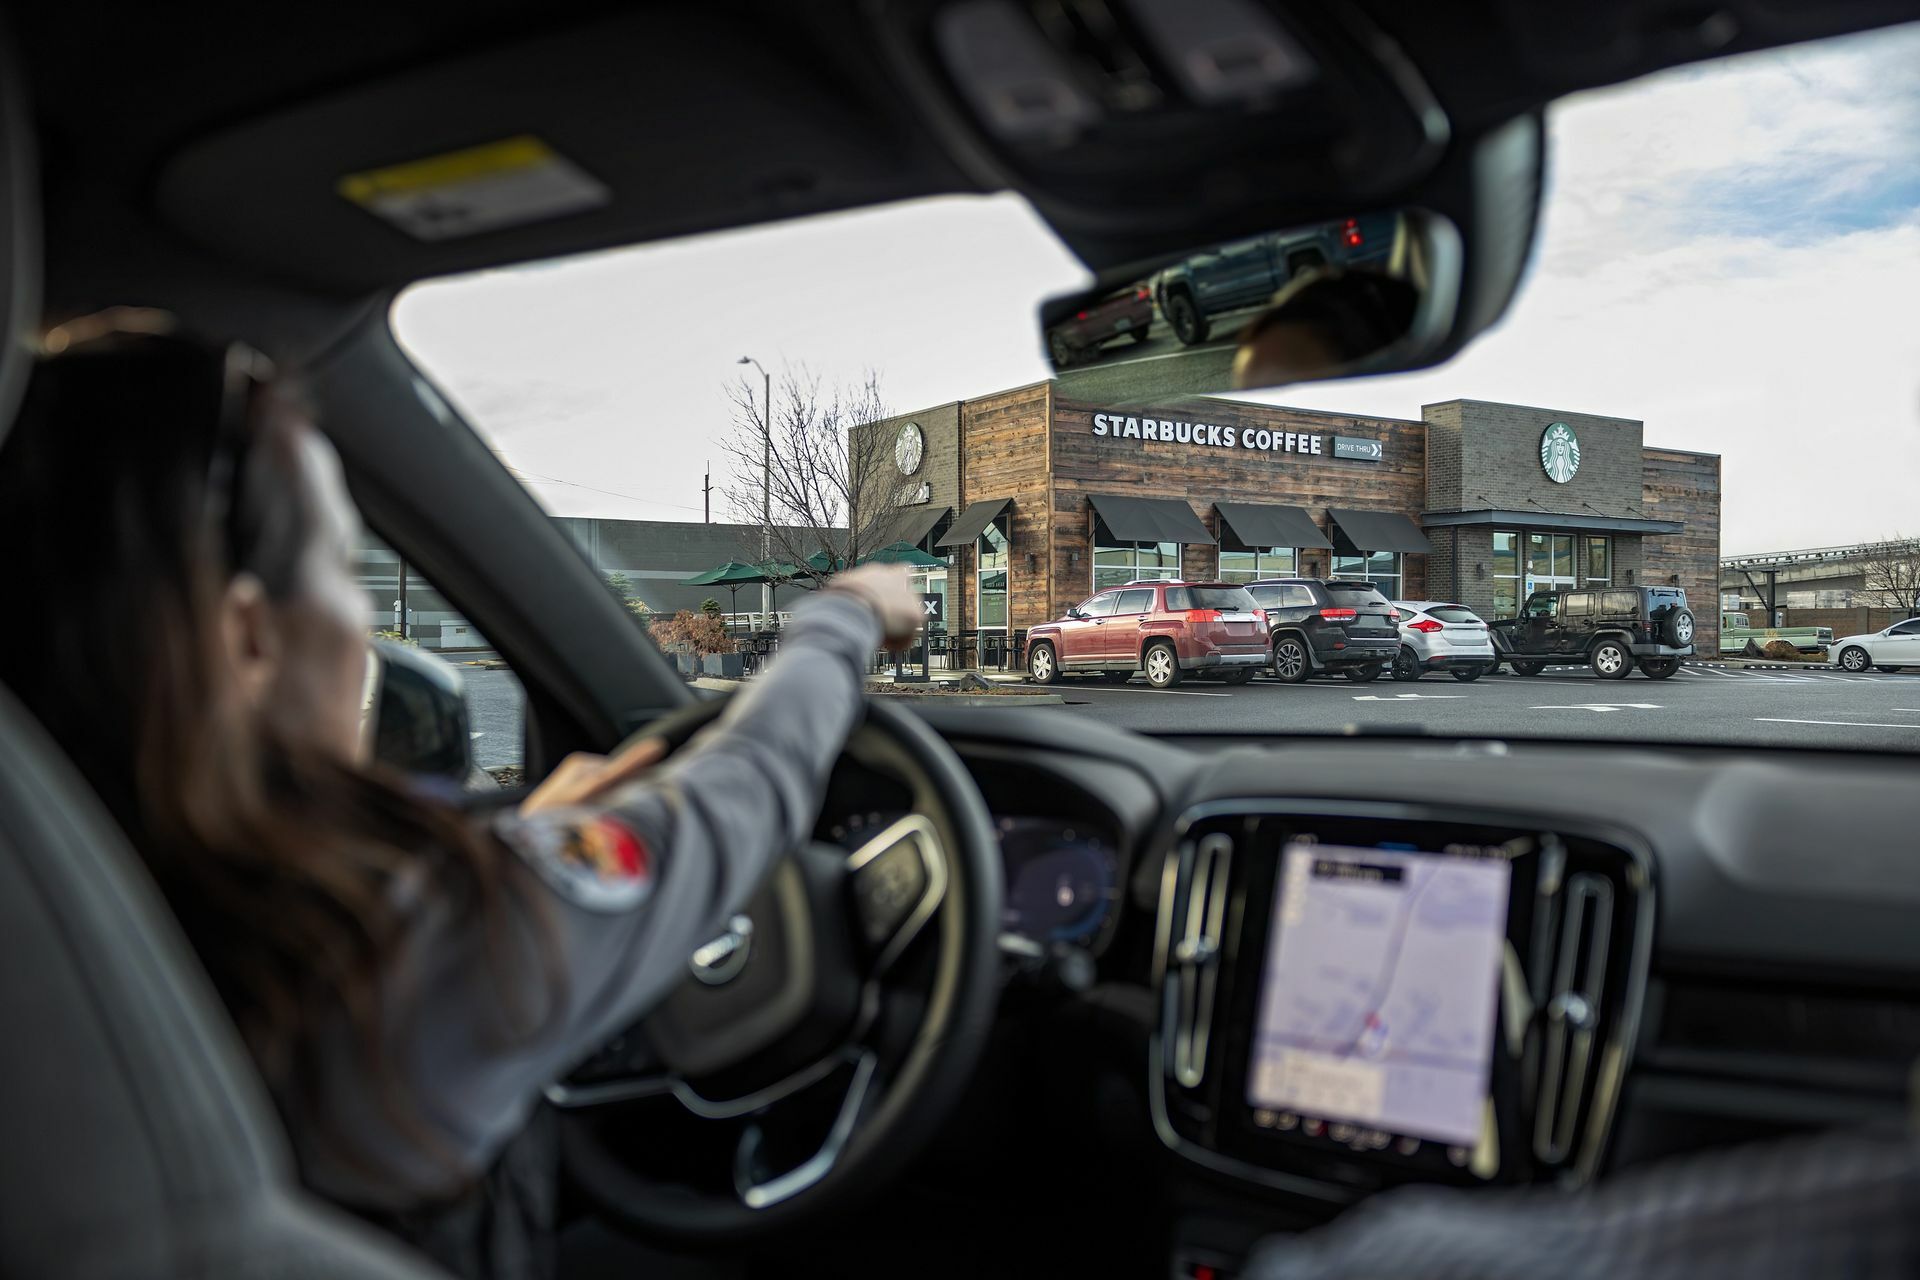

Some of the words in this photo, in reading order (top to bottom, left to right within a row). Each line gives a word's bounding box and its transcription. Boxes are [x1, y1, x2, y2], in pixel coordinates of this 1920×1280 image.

[1093, 413, 1236, 447] STARBUCKS
[1242, 428, 1322, 455] COFFEE
[1337, 443, 1355, 452] DRIVE
[1356, 445, 1371, 453] THRU
